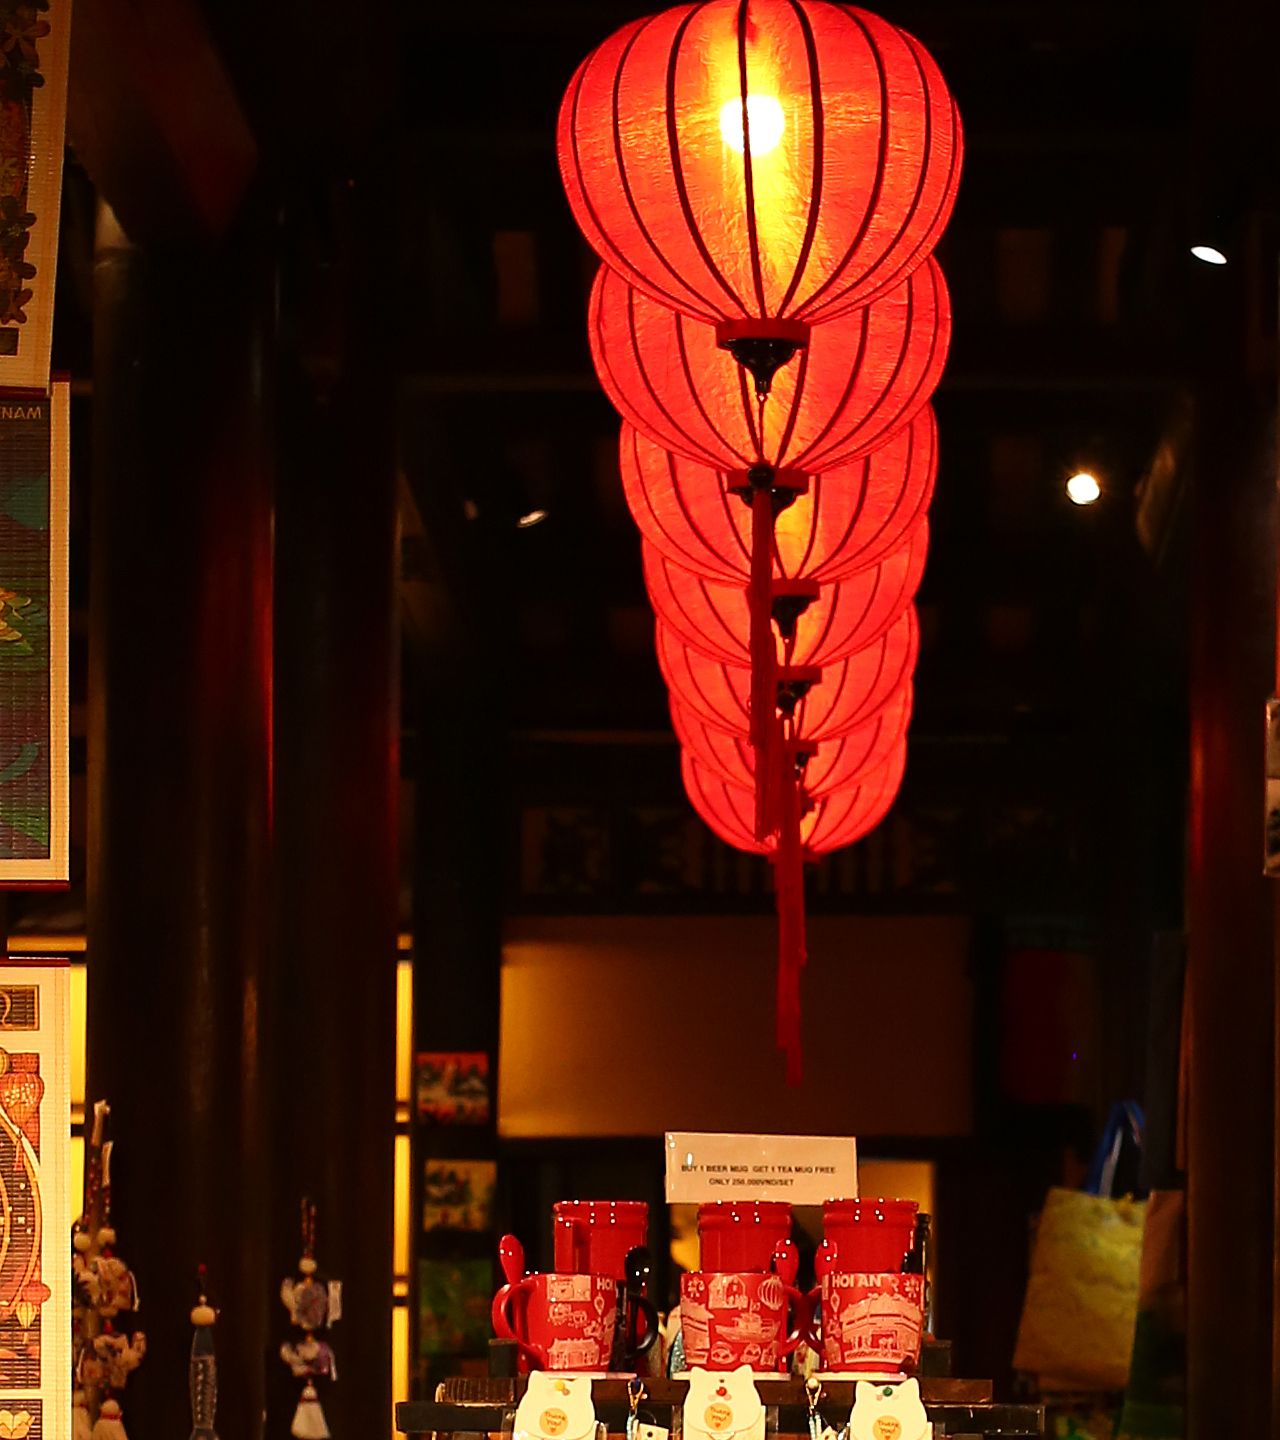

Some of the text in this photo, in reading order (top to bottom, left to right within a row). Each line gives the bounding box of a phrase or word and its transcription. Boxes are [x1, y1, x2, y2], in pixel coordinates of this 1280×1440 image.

[681, 1164, 698, 1173] BUY
[706, 1164, 728, 1173] BEER
[752, 1165, 769, 1173] GET
[777, 1165, 793, 1174] TEA
[814, 1166, 835, 1174] FREE
[708, 1178, 730, 1186] ONLY
[831, 1275, 882, 1289] HOI AN
